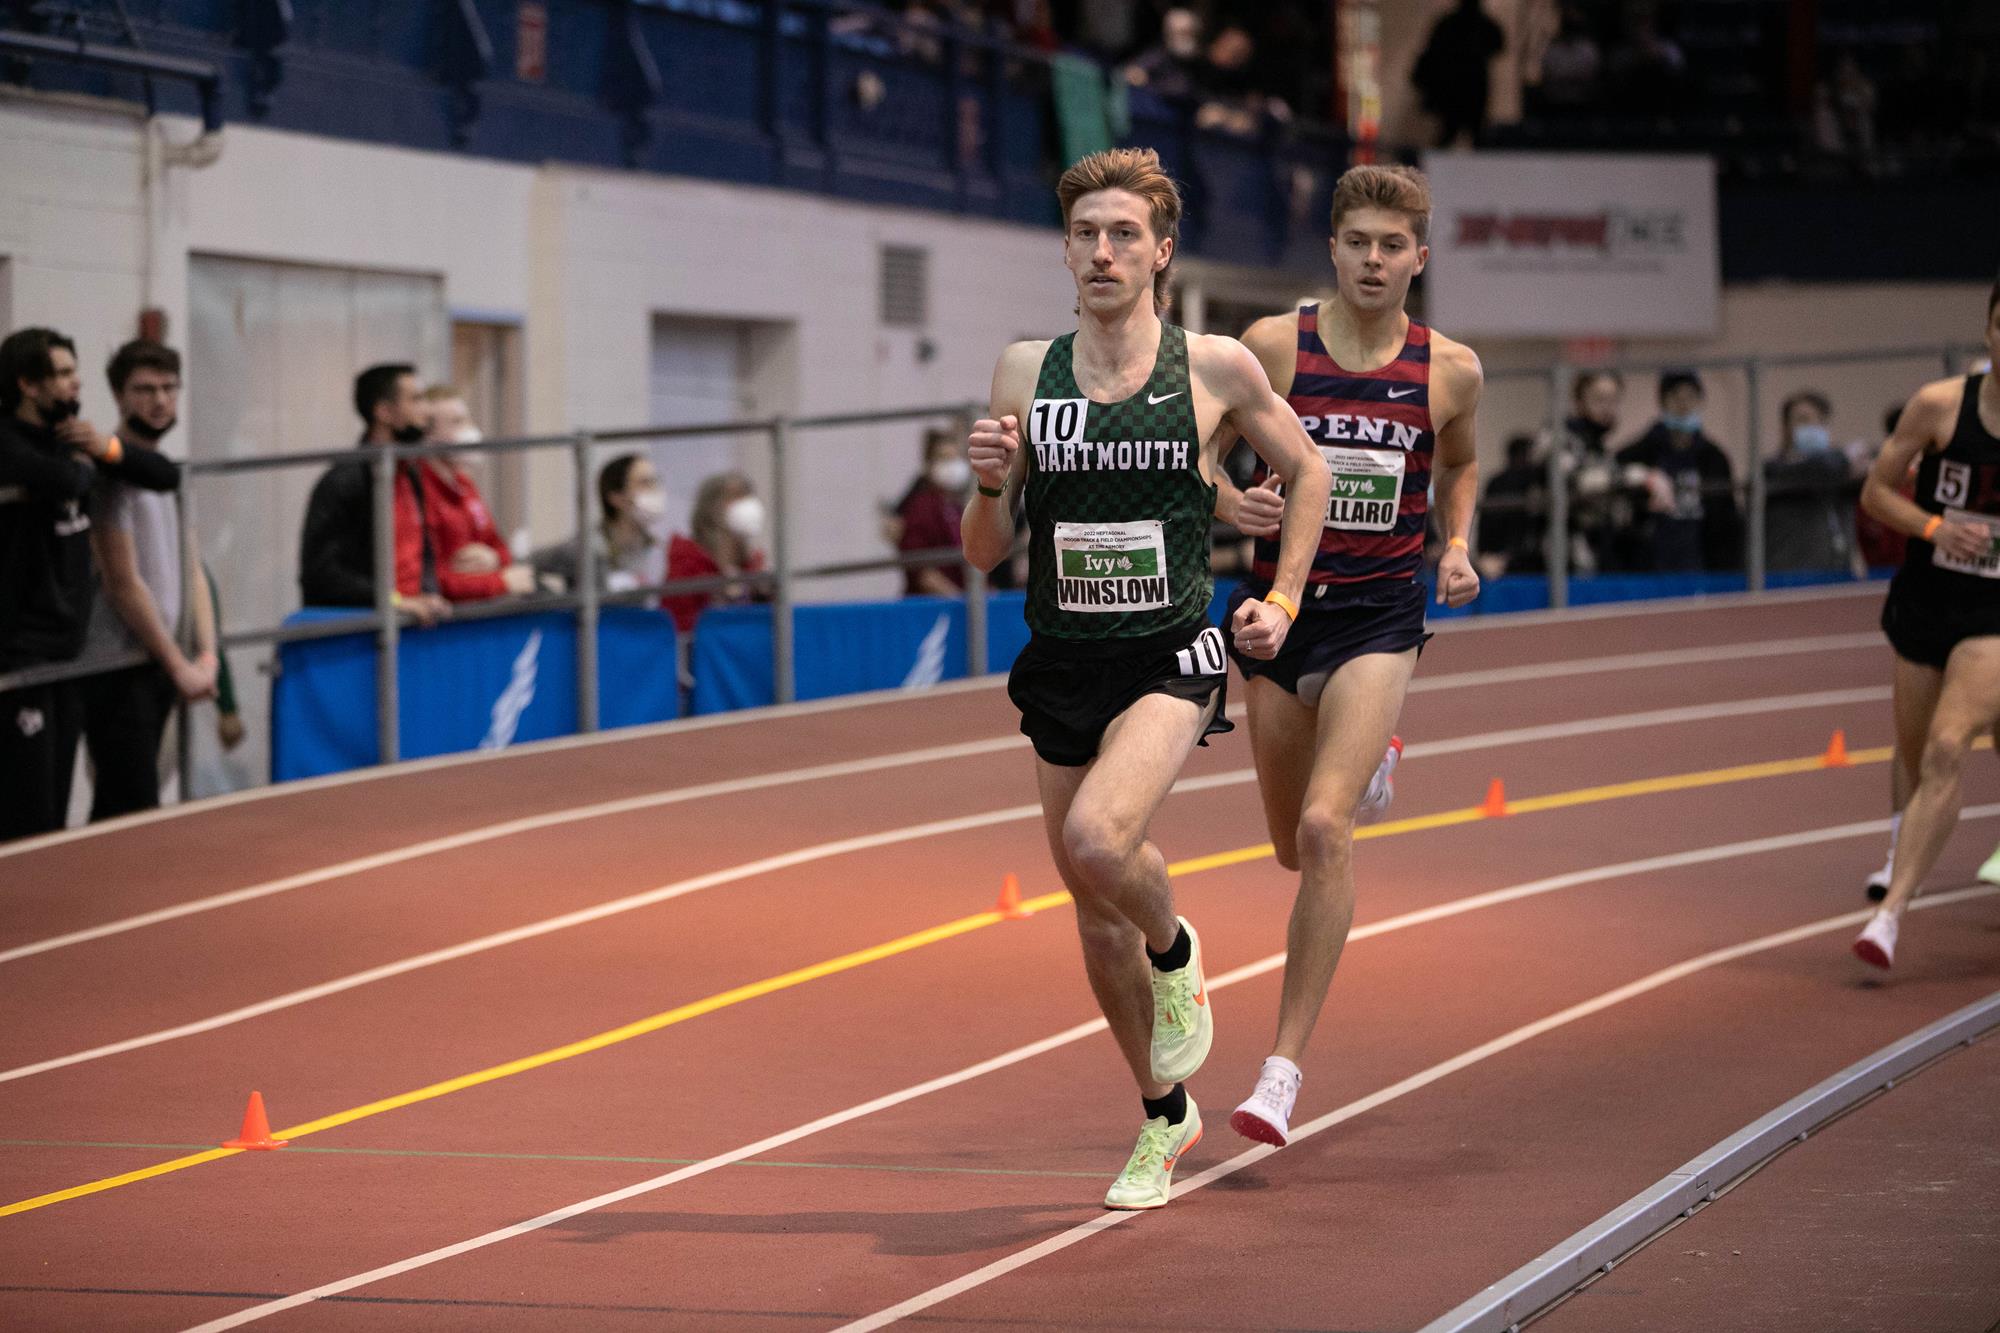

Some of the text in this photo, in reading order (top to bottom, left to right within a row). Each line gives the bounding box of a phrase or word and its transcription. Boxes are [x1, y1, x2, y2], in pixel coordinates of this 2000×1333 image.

[1035, 401, 1078, 442] 10
[1300, 414, 1422, 451] PENN
[1035, 441, 1189, 472] DARTMOUTH
[1331, 476, 1361, 496] Ivy
[1942, 467, 1963, 500] 5
[1326, 500, 1394, 524] LLARO
[1084, 554, 1115, 575] Ivy
[1059, 577, 1165, 605] WINSLOW
[1189, 630, 1223, 674] 10
